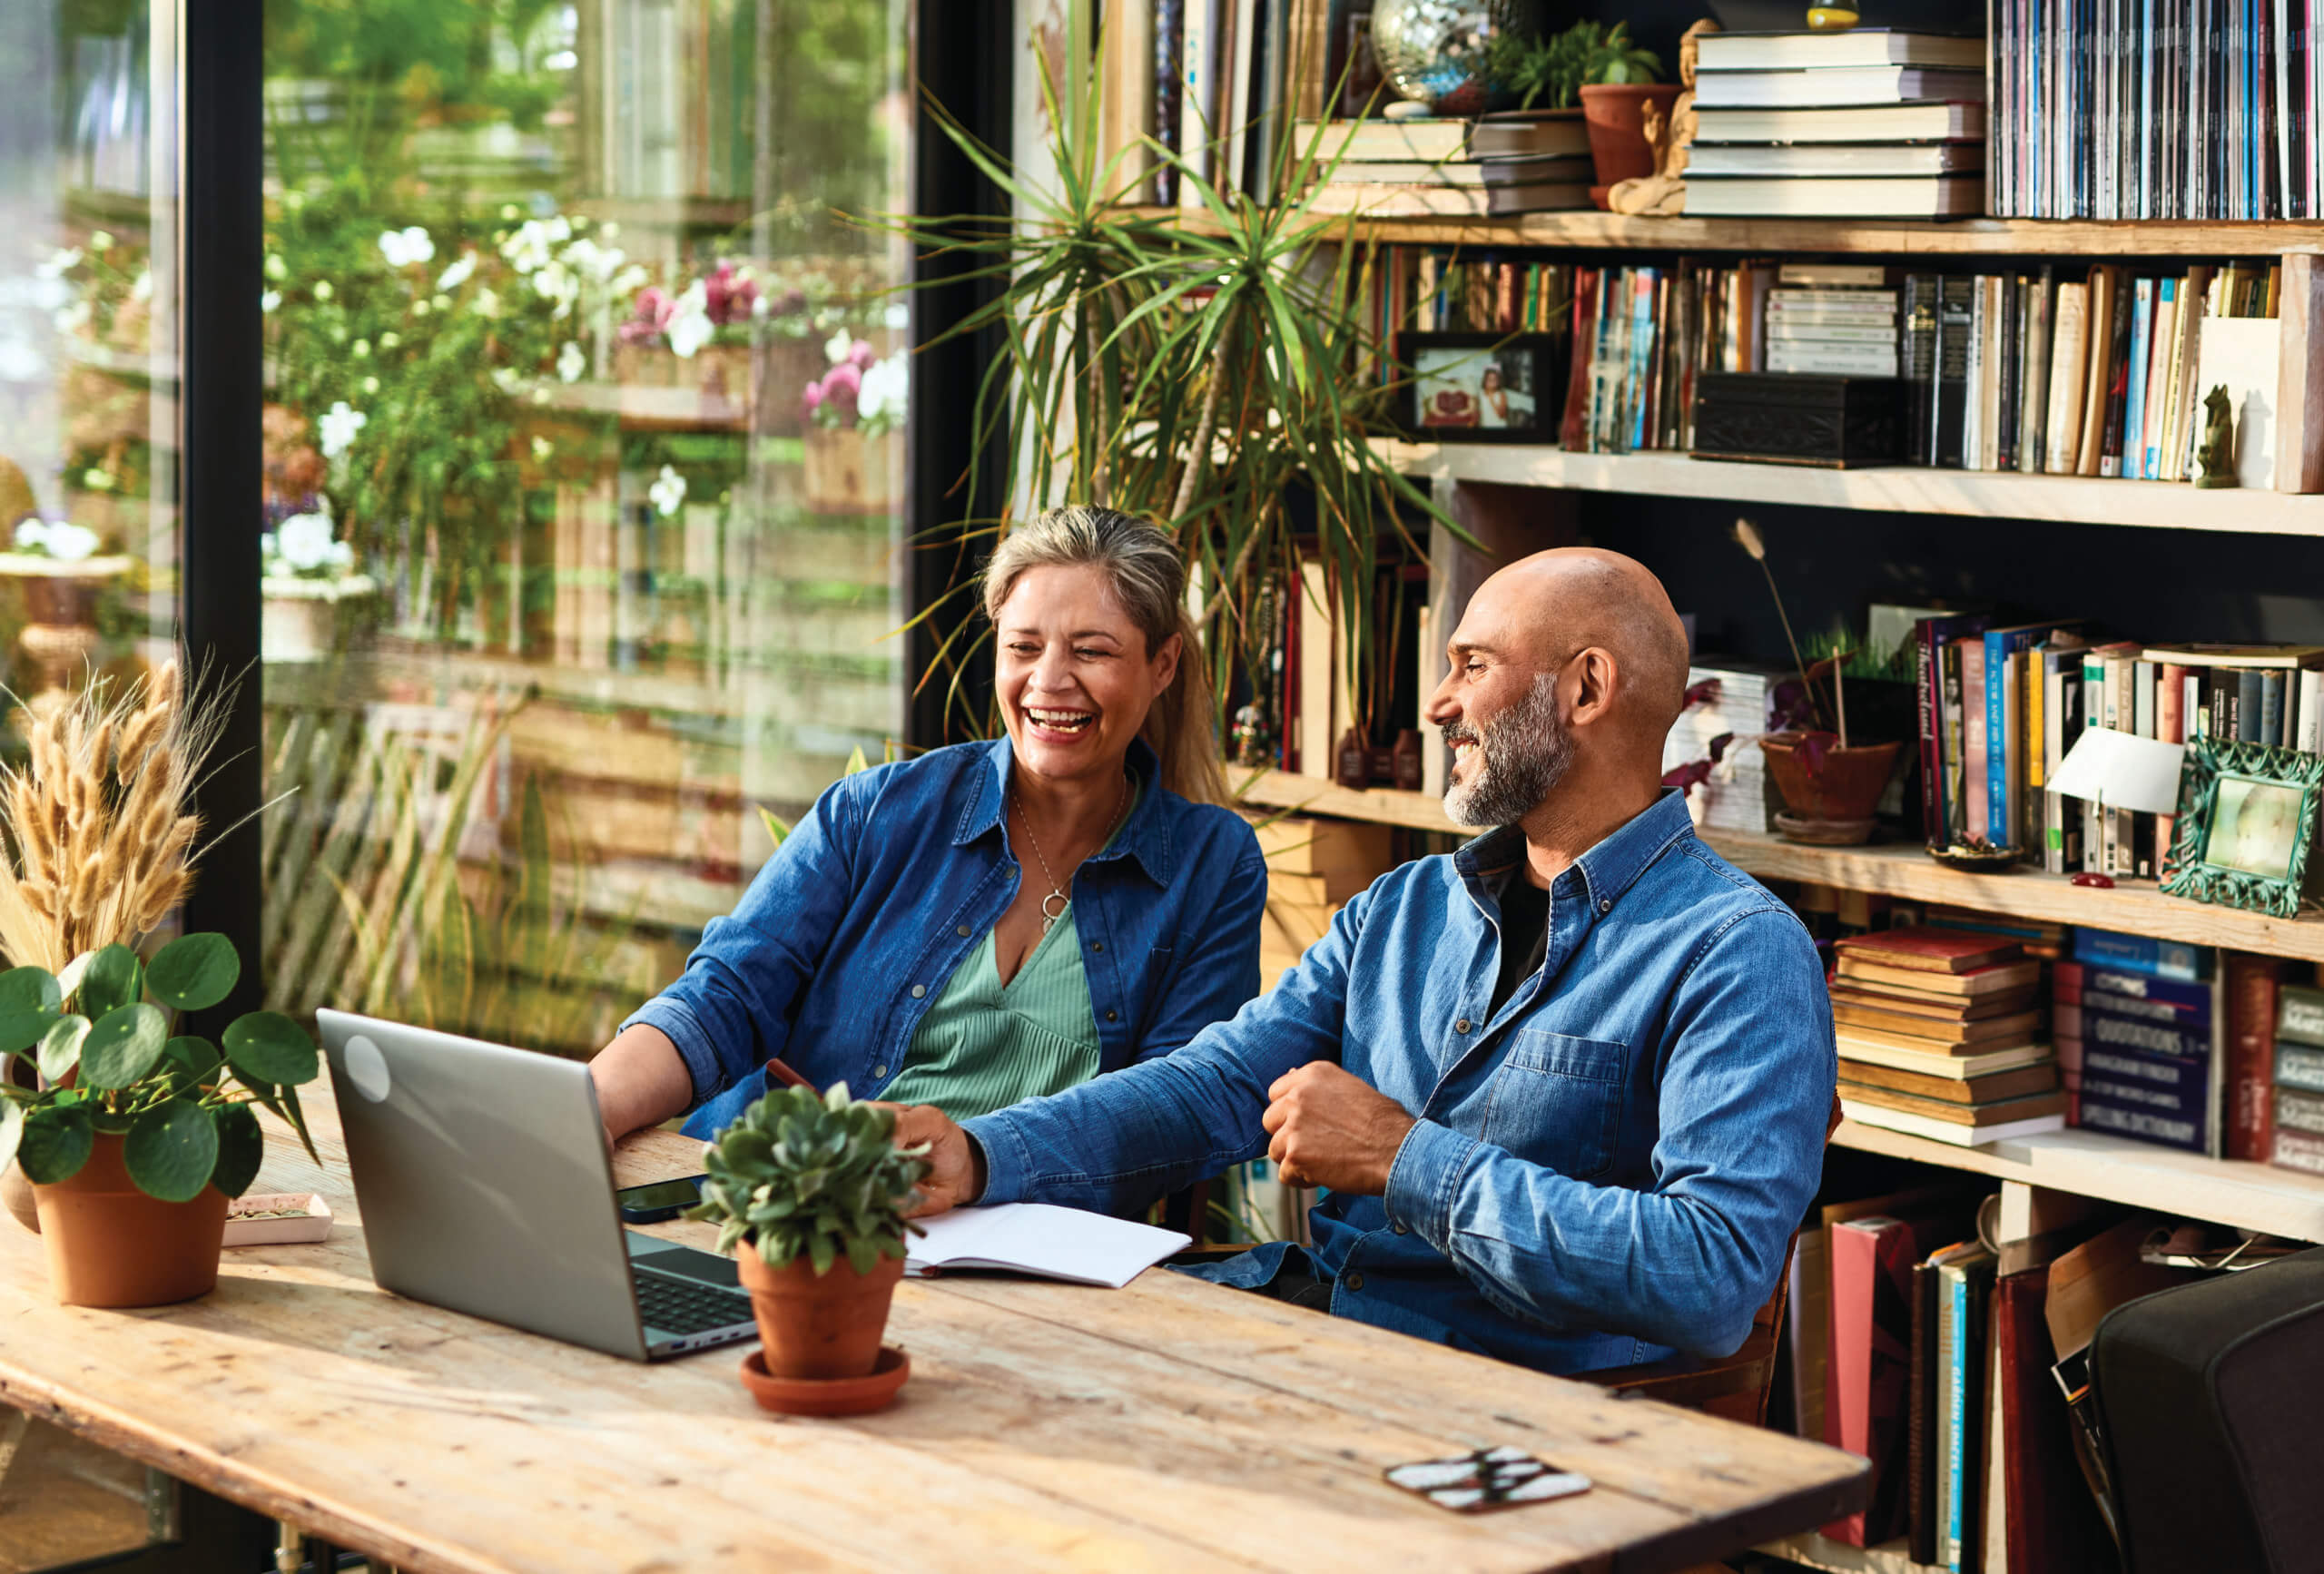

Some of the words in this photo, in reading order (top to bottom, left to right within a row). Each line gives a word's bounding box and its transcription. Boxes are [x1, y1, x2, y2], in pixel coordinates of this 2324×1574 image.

[1916, 641, 1935, 741] Theatreland
[2095, 1018, 2181, 1055] QUOTATIONS
[2131, 1113, 2196, 1144] DICTIONARY
[1951, 1365, 1962, 1422] GARDEN
[1949, 1423, 1961, 1471] SPACES
